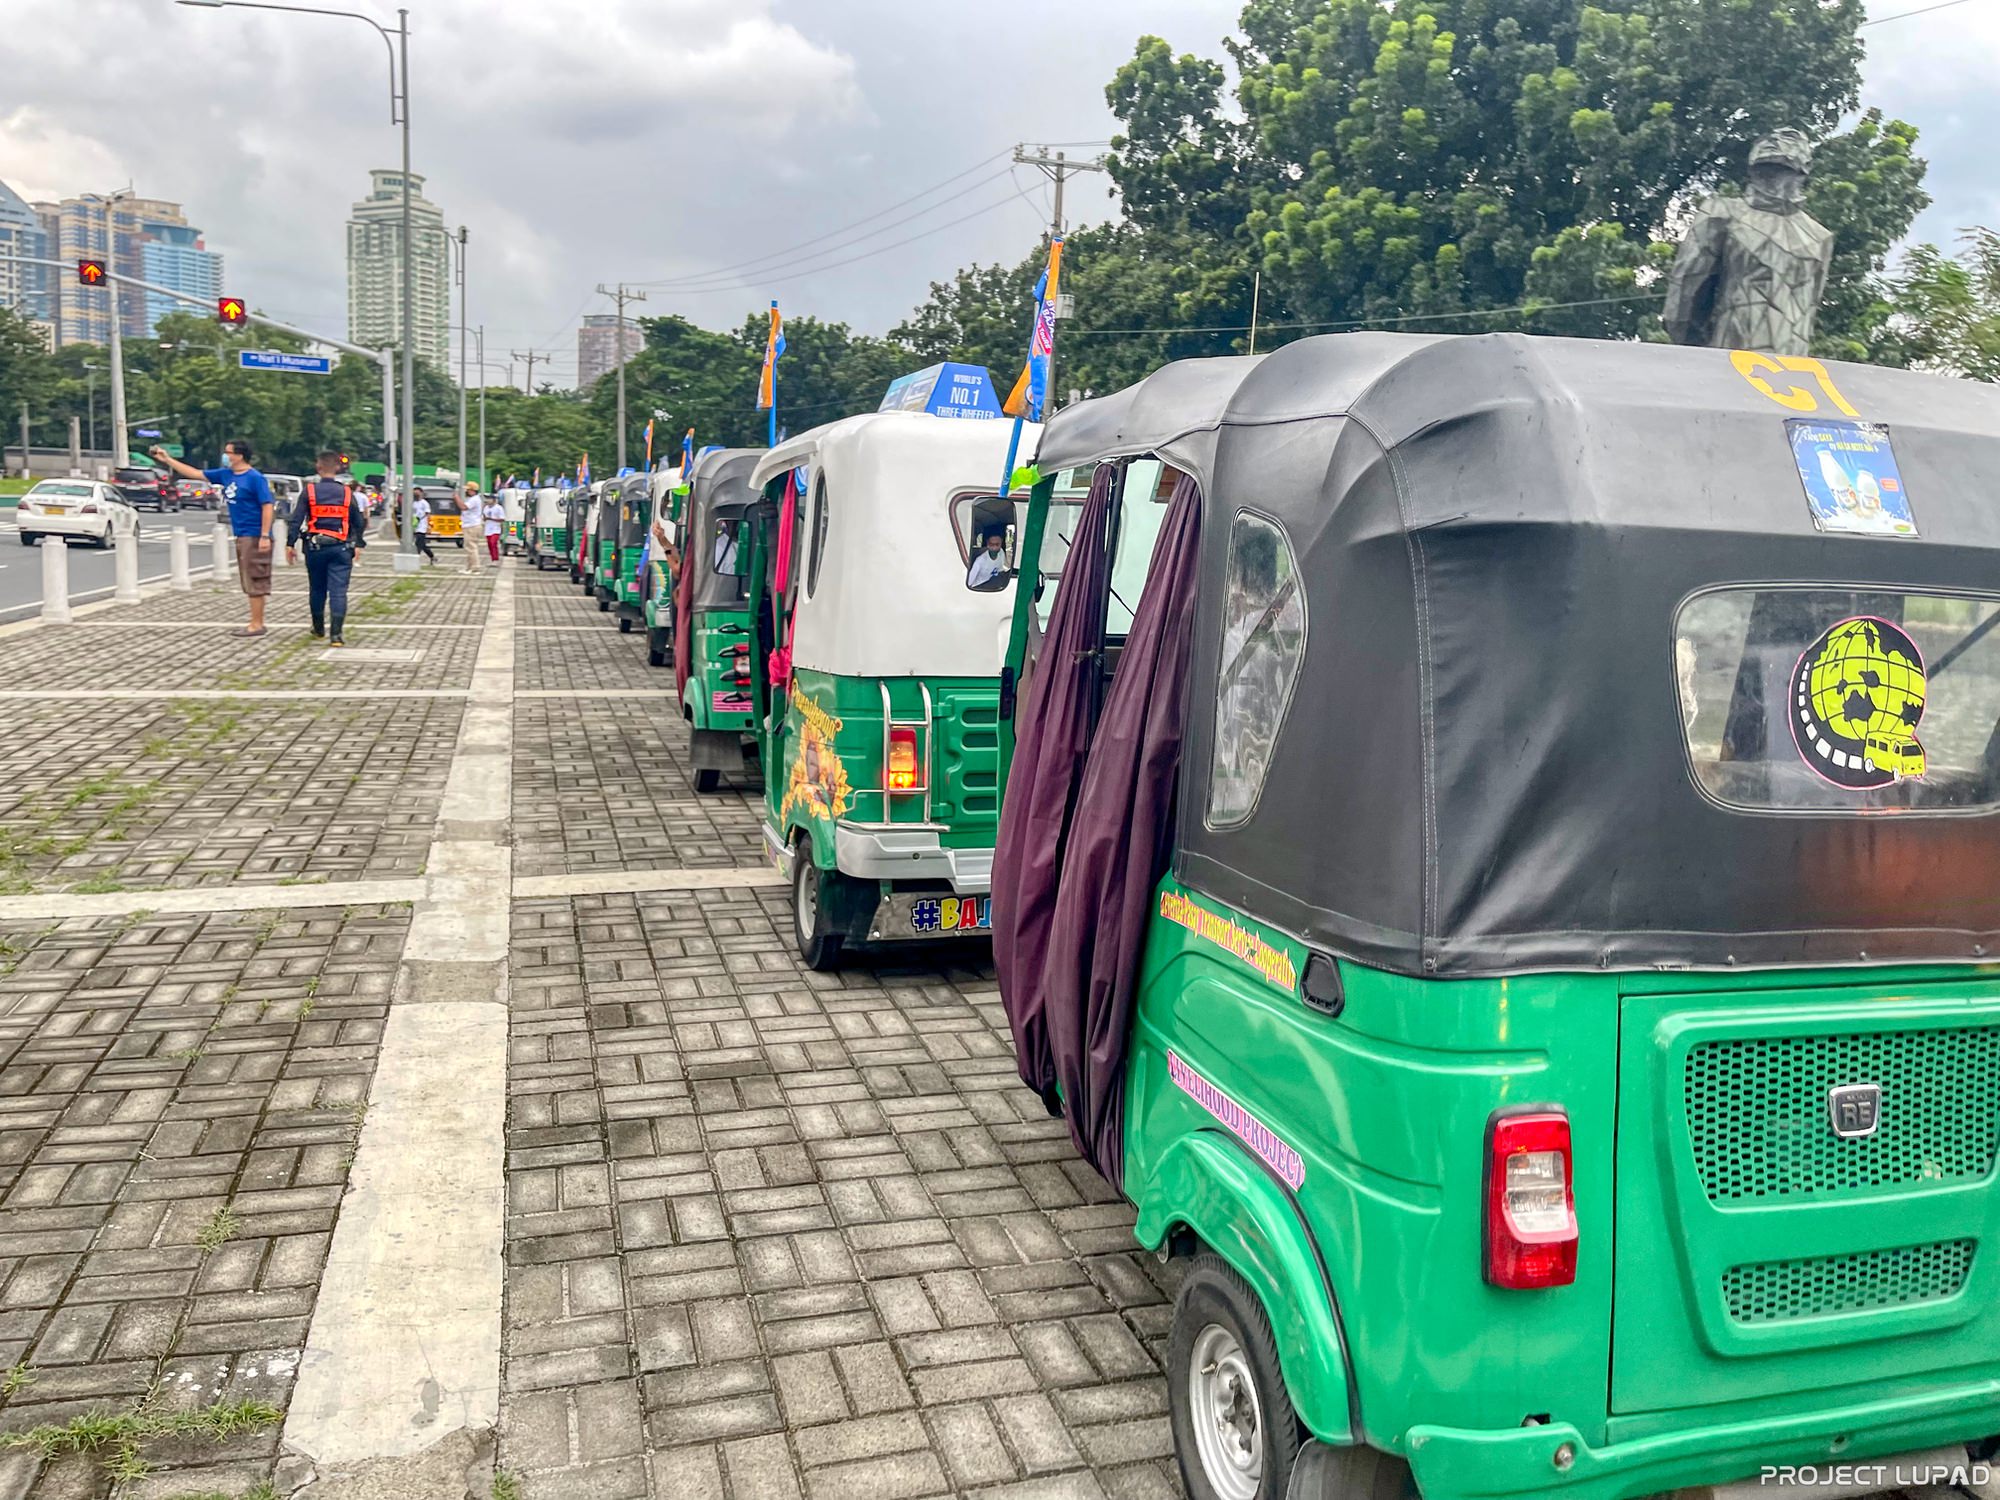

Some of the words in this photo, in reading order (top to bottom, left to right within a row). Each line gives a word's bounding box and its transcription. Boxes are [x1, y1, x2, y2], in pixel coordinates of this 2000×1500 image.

[281, 355, 321, 367] Museum
[953, 374, 982, 385] WORLD'S
[911, 897, 992, 932] #BAJ
[1168, 1051, 1241, 1130] LIVELIHOOD
[1242, 1111, 1306, 1187] PROJECT
[1841, 1101, 1872, 1127] RE
